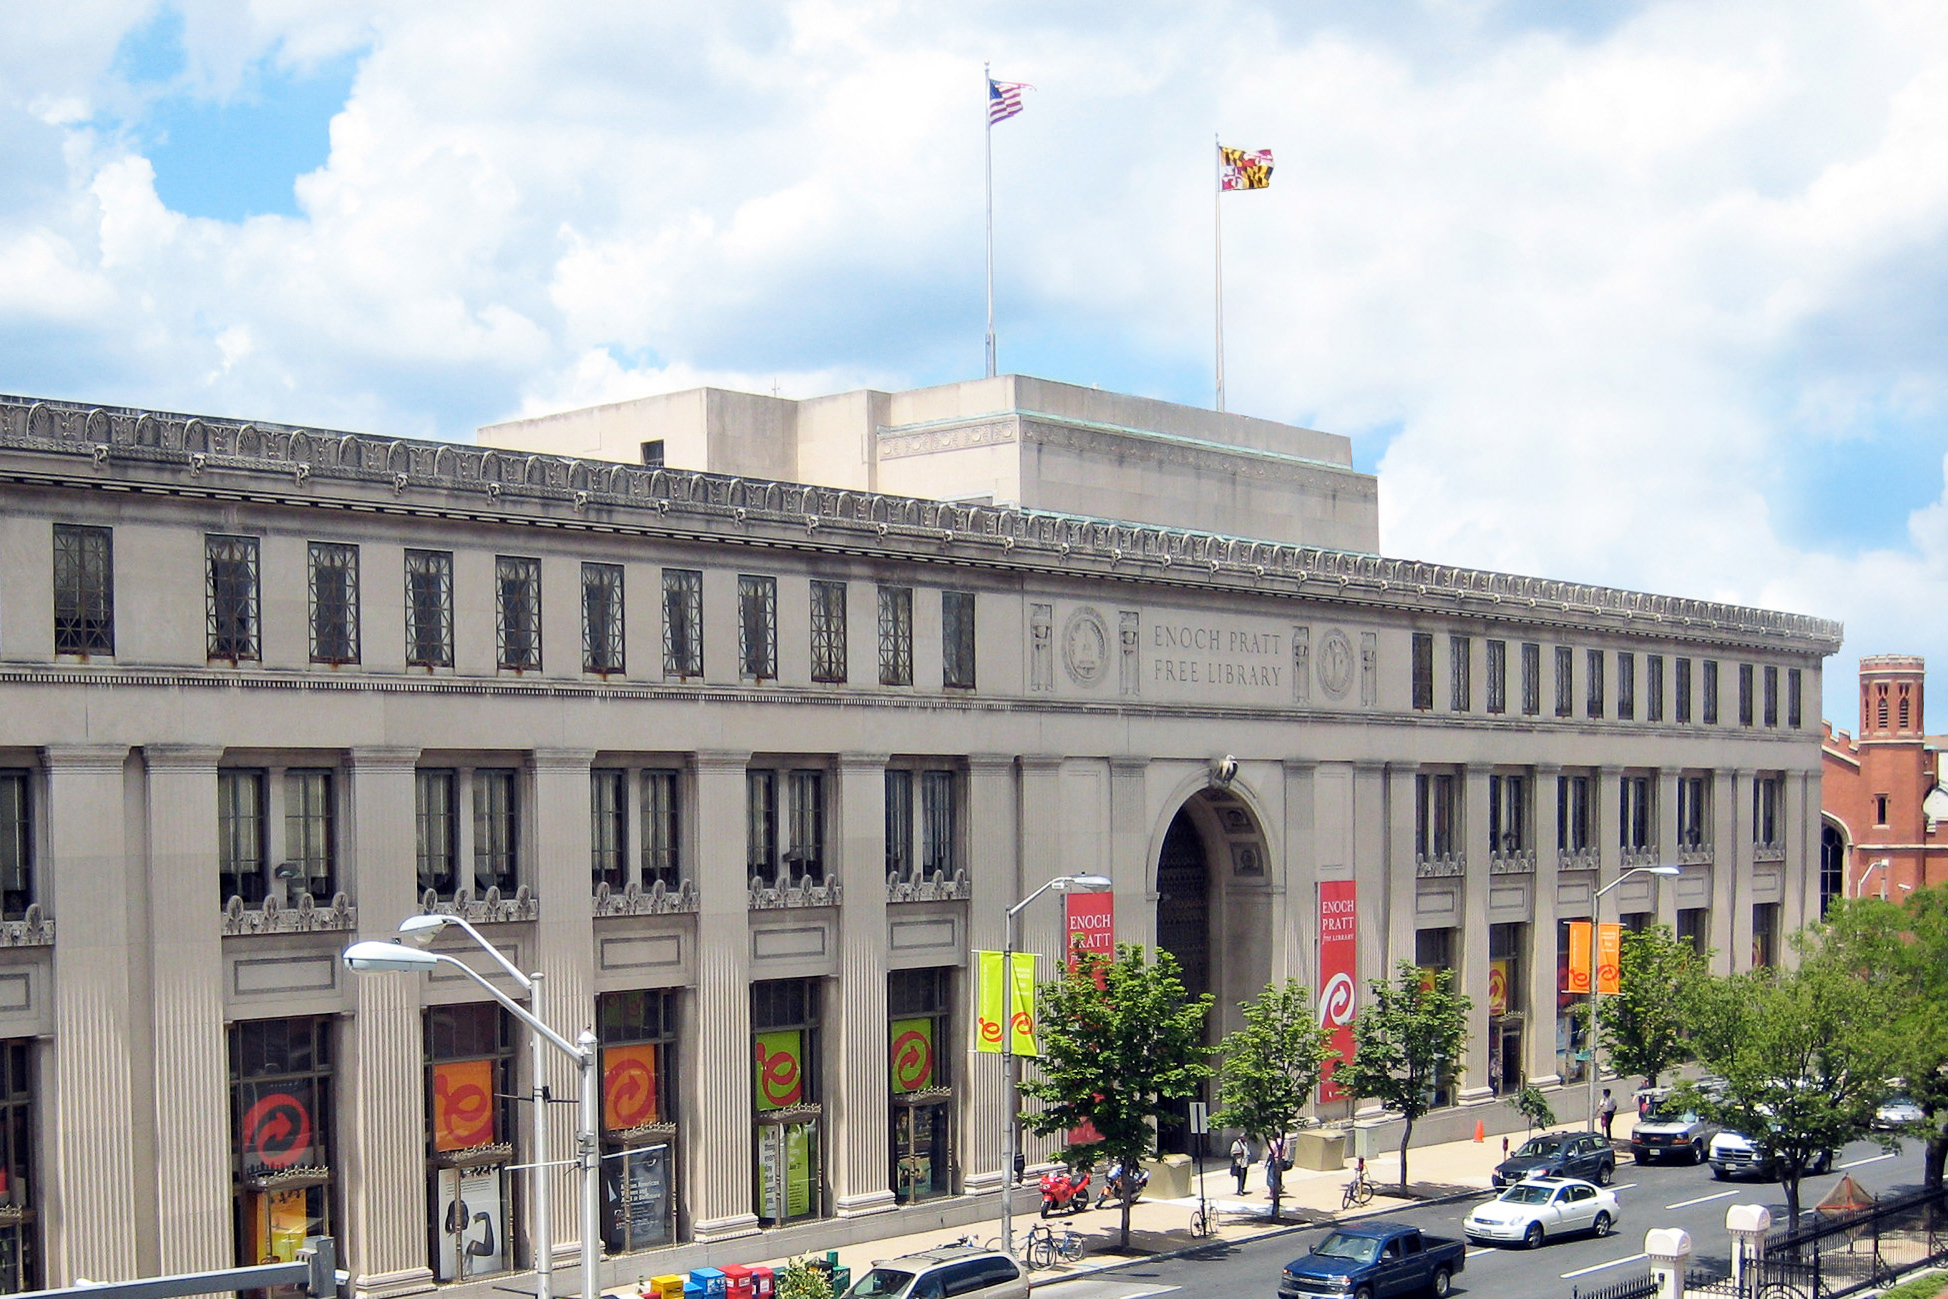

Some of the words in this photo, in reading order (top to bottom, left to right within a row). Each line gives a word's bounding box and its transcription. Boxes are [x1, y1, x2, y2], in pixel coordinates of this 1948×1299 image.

[1154, 625, 1220, 651] ENOCH
[1230, 631, 1281, 655] PRATT
[1154, 659, 1199, 683] FREE
[1207, 662, 1282, 687] LIBRARY
[1321, 899, 1355, 914] ENOCH
[1069, 914, 1111, 930] ENOCH
[1321, 916, 1355, 931] PRATT
